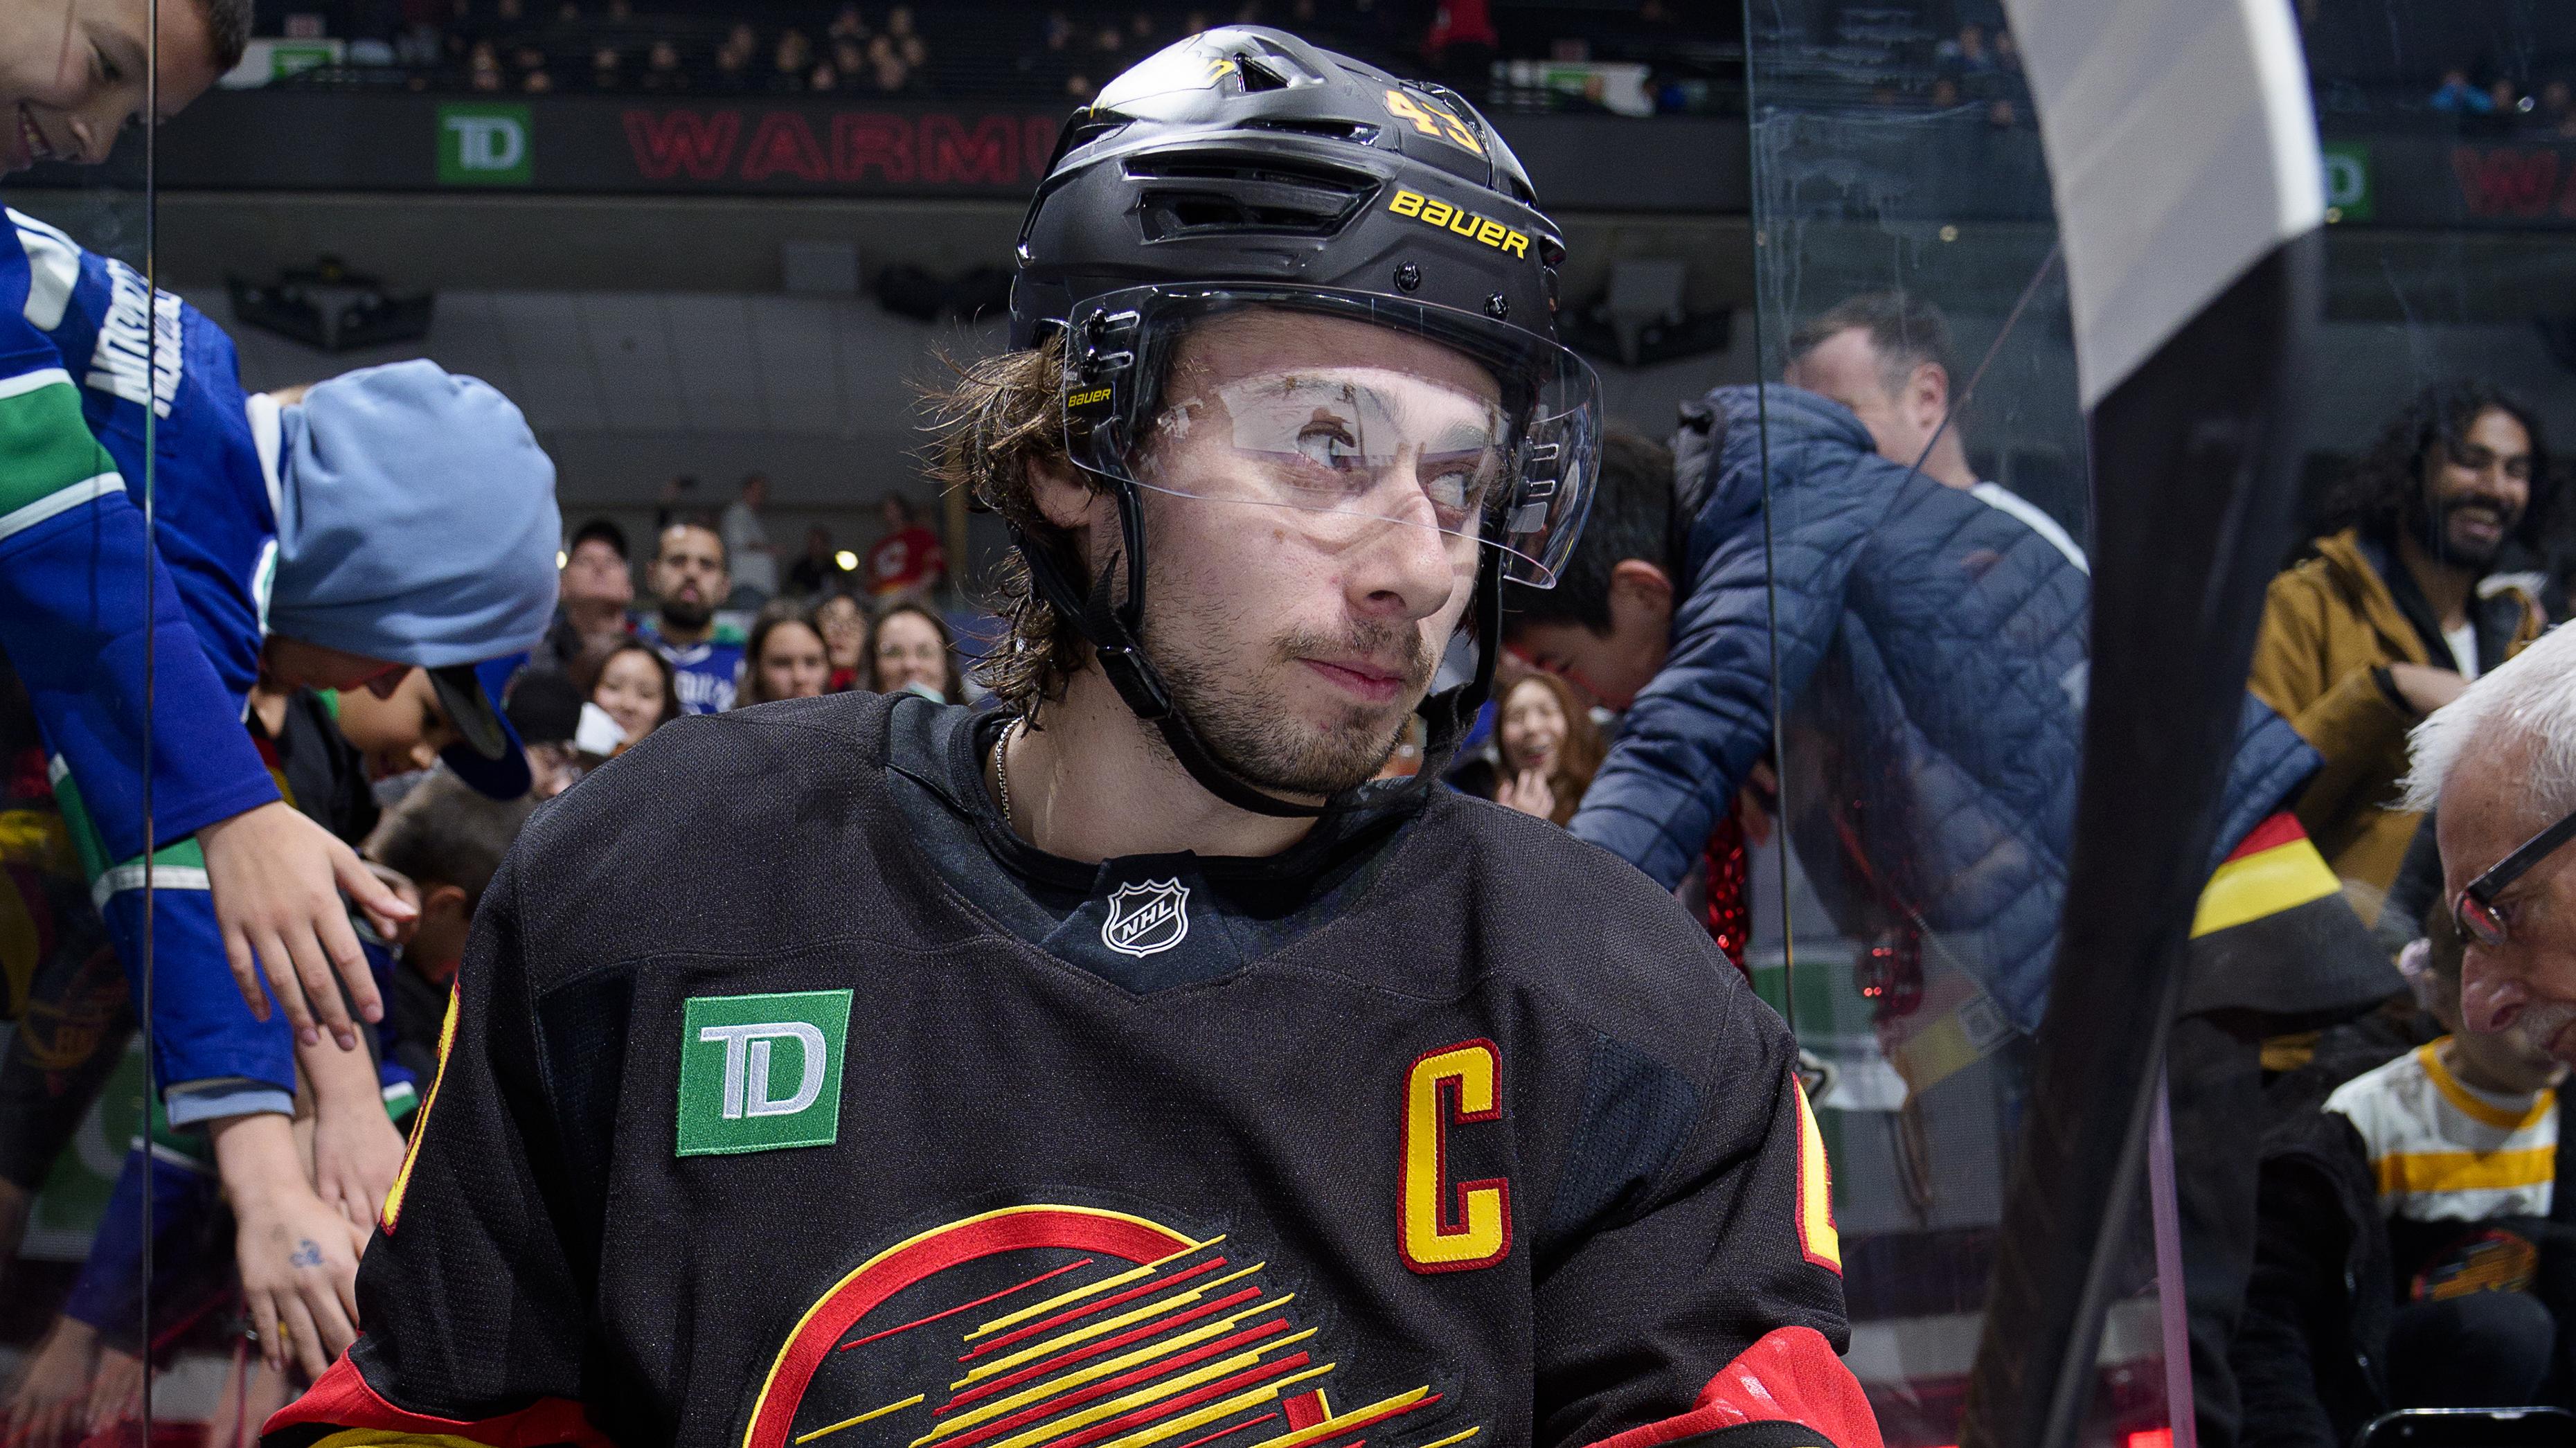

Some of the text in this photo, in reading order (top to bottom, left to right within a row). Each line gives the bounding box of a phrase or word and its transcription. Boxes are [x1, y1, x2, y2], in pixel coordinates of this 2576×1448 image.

[447, 116, 525, 170] TD
[1386, 89, 1483, 154] 43
[1122, 900, 1172, 940] NHL
[700, 1021, 827, 1119] TD
[1397, 1037, 1512, 1275] C
